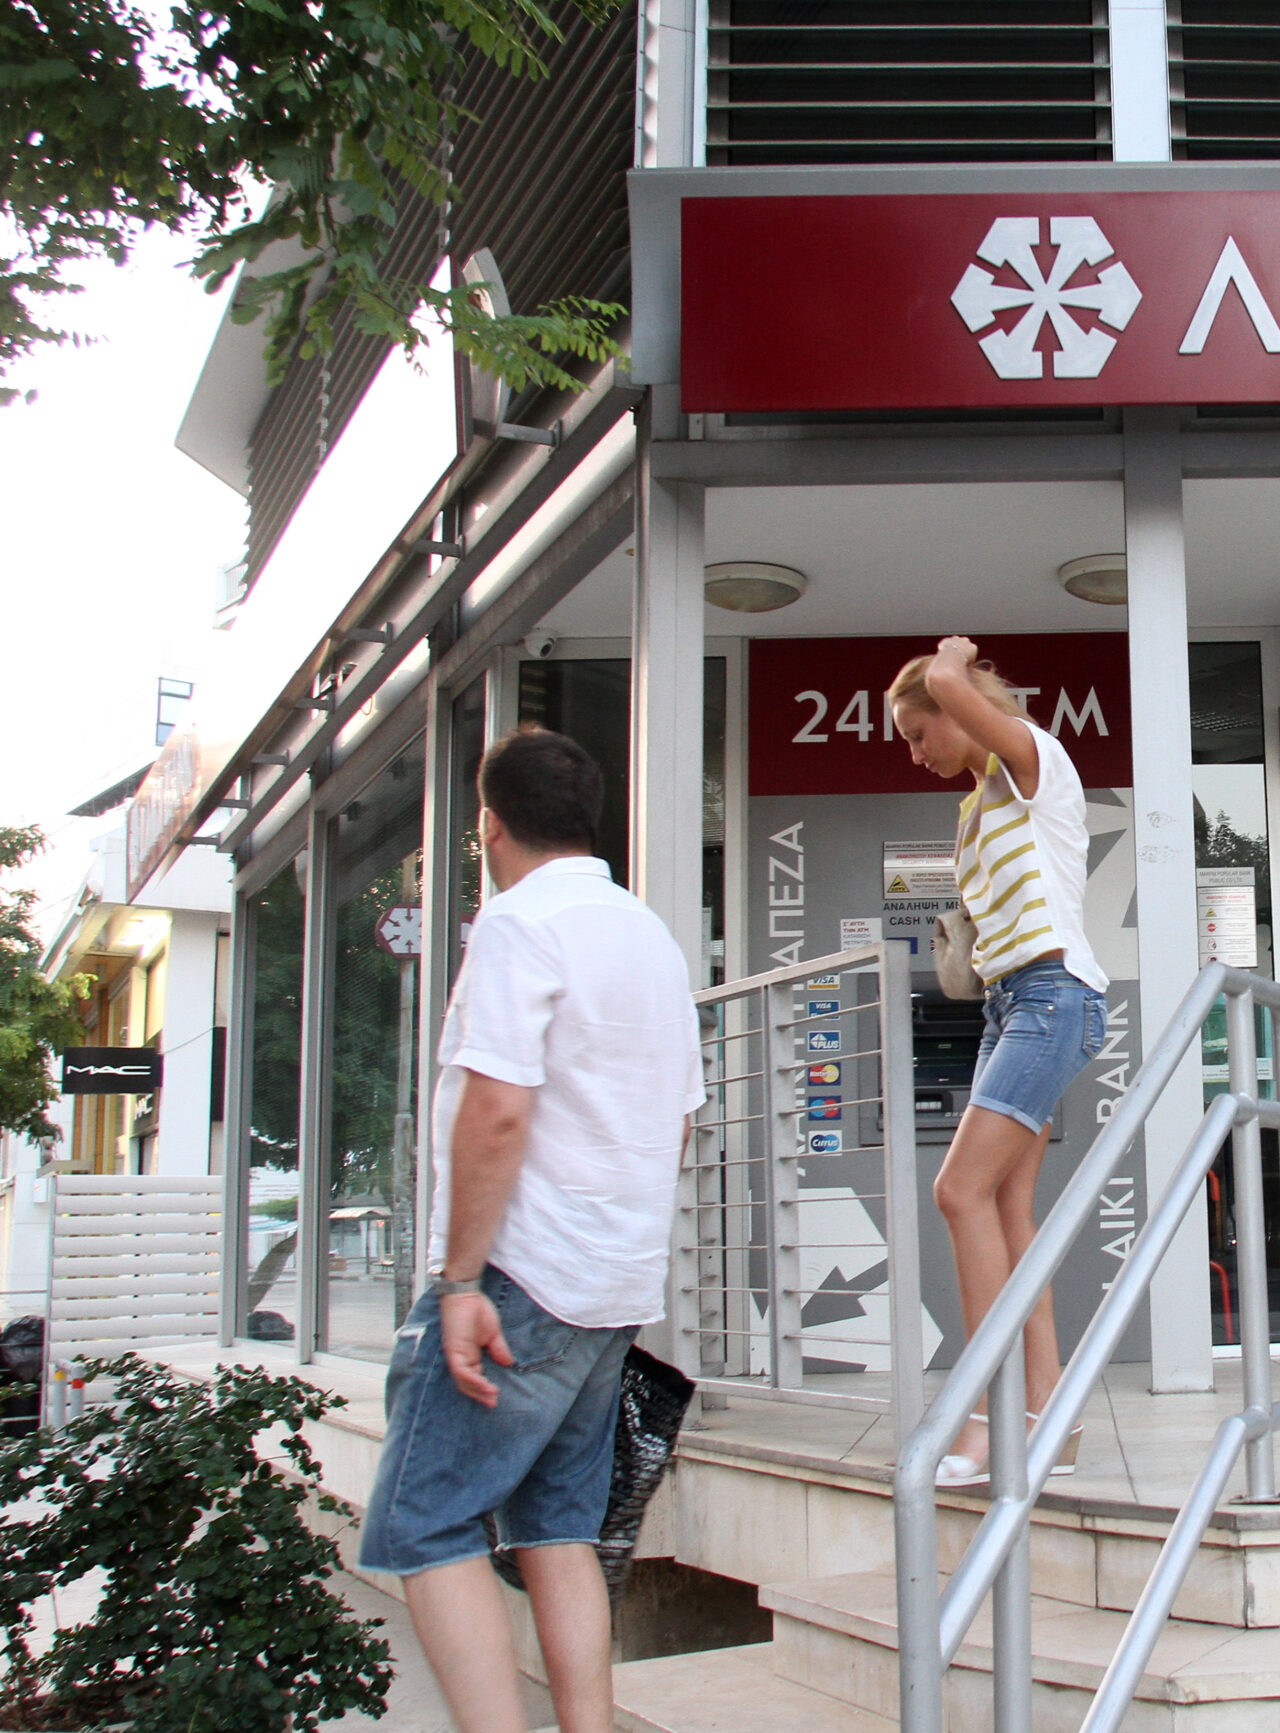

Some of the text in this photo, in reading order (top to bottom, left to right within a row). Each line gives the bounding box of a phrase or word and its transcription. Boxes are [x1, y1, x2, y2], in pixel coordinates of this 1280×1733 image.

[1003, 685, 1110, 737] TM
[883, 901, 939, 912] ΑΝΑΛΗΨΗ
[889, 916, 921, 926] CASH
[813, 976, 836, 985] VISA
[815, 1002, 832, 1010] VISA
[818, 1040, 840, 1050] PLUS
[66, 1065, 152, 1076] MAC
[812, 1137, 839, 1148] Cirrus
